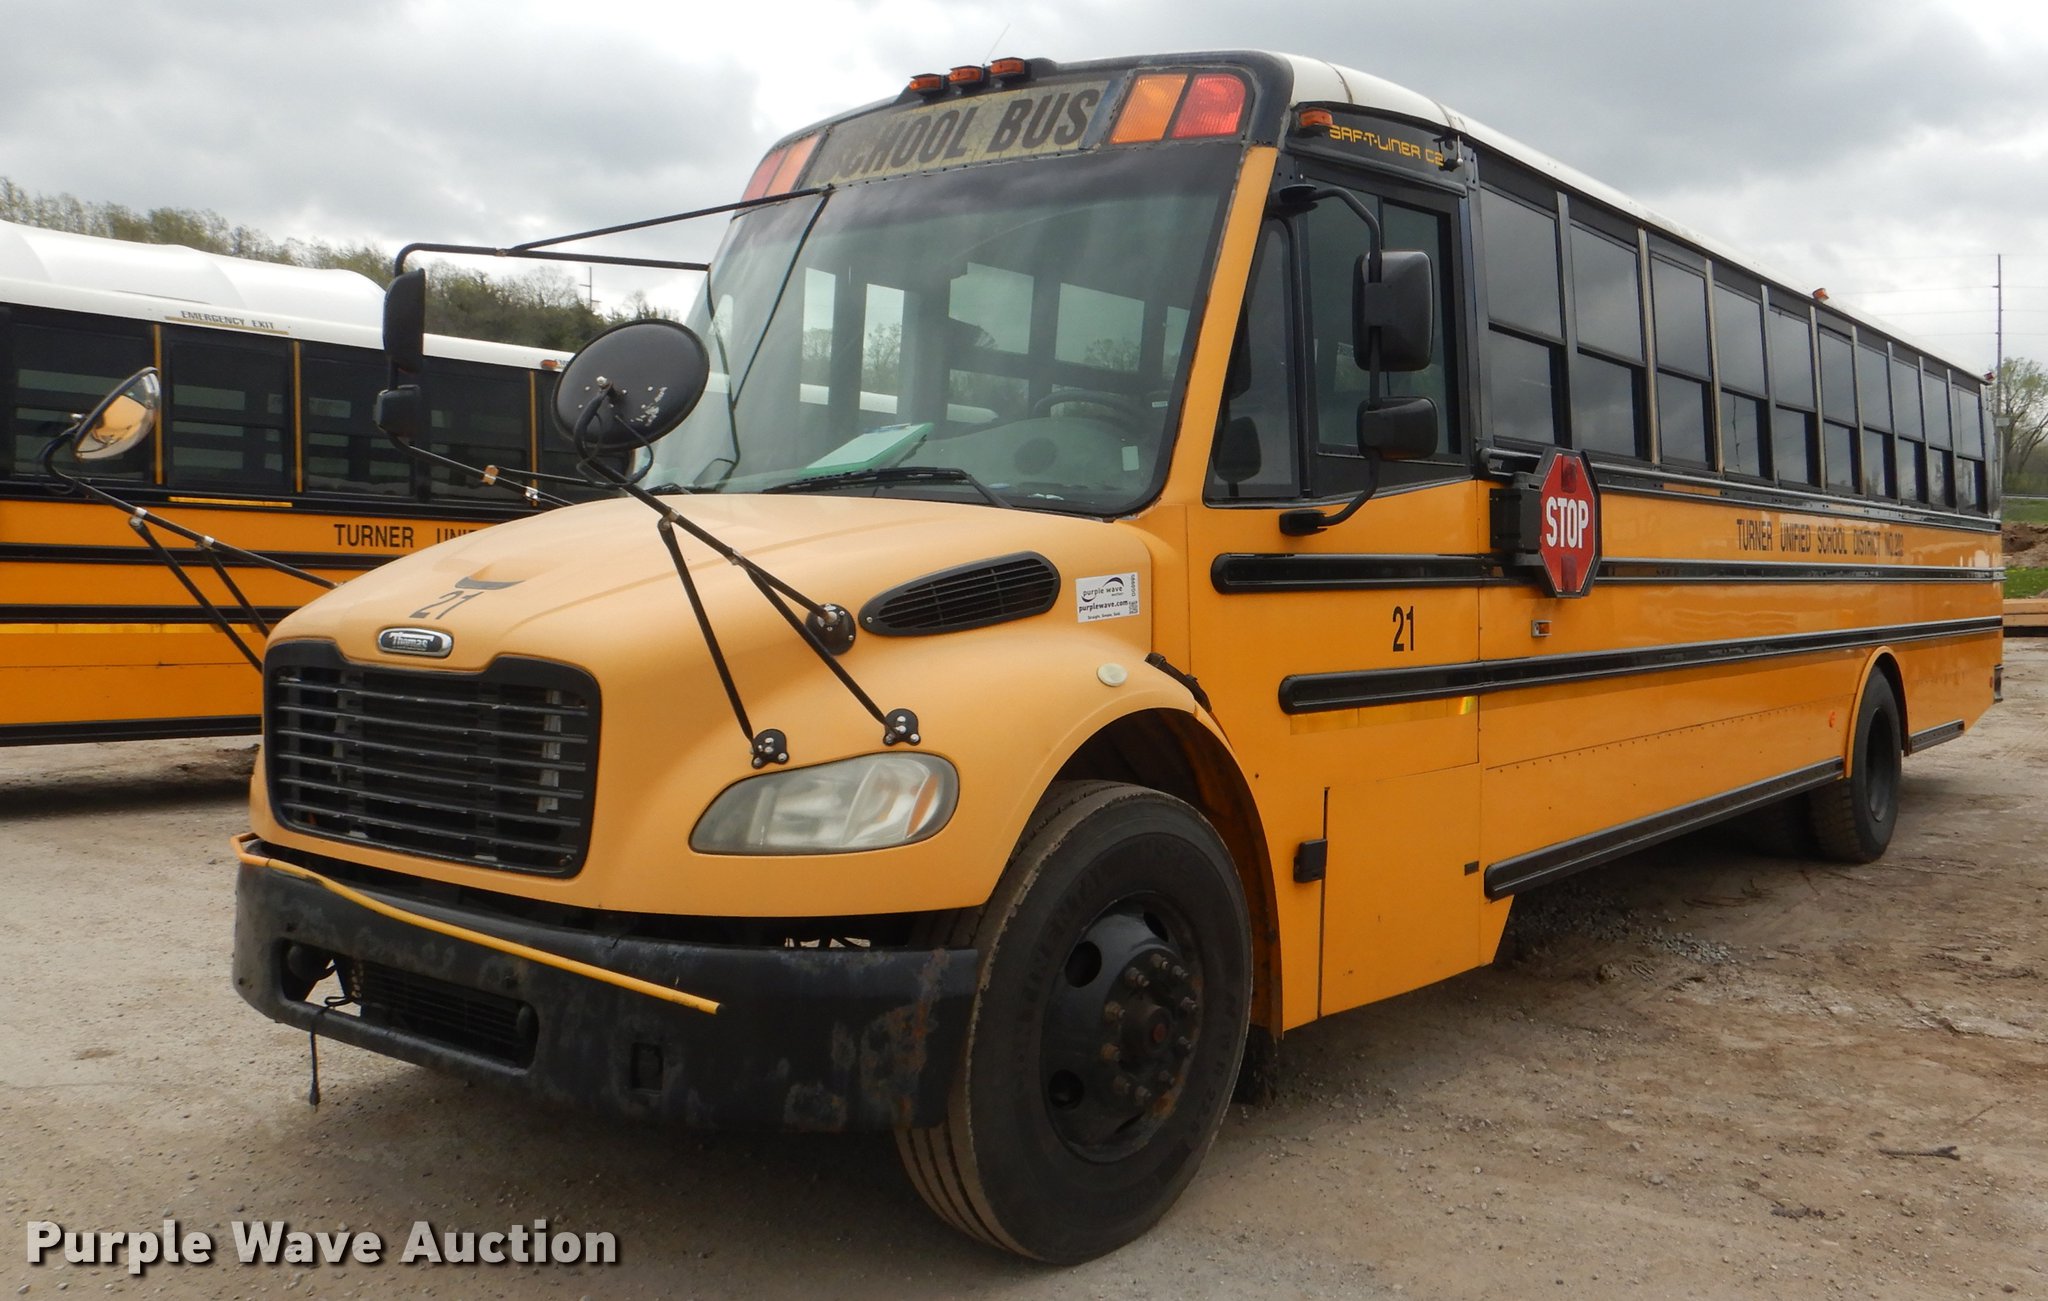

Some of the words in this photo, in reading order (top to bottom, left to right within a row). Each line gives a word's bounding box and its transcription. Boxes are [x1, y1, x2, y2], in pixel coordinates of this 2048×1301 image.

[815, 107, 979, 184] CHOOL
[985, 88, 1099, 155] BUS
[1425, 148, 1445, 167] C2
[180, 310, 245, 326] EMERGENCY
[251, 319, 275, 329] EXIT
[1546, 496, 1588, 548] STOP
[333, 523, 414, 548] TURNER
[1736, 518, 1773, 551] TURNER
[1780, 522, 1811, 552] UNIFIED
[1817, 526, 1847, 554] SCHOOL
[409, 590, 484, 620] 21
[1083, 588, 1104, 597] purple
[1079, 600, 1128, 613] purplewave.com
[389, 632, 434, 648] Thomas
[1392, 606, 1414, 651] 21
